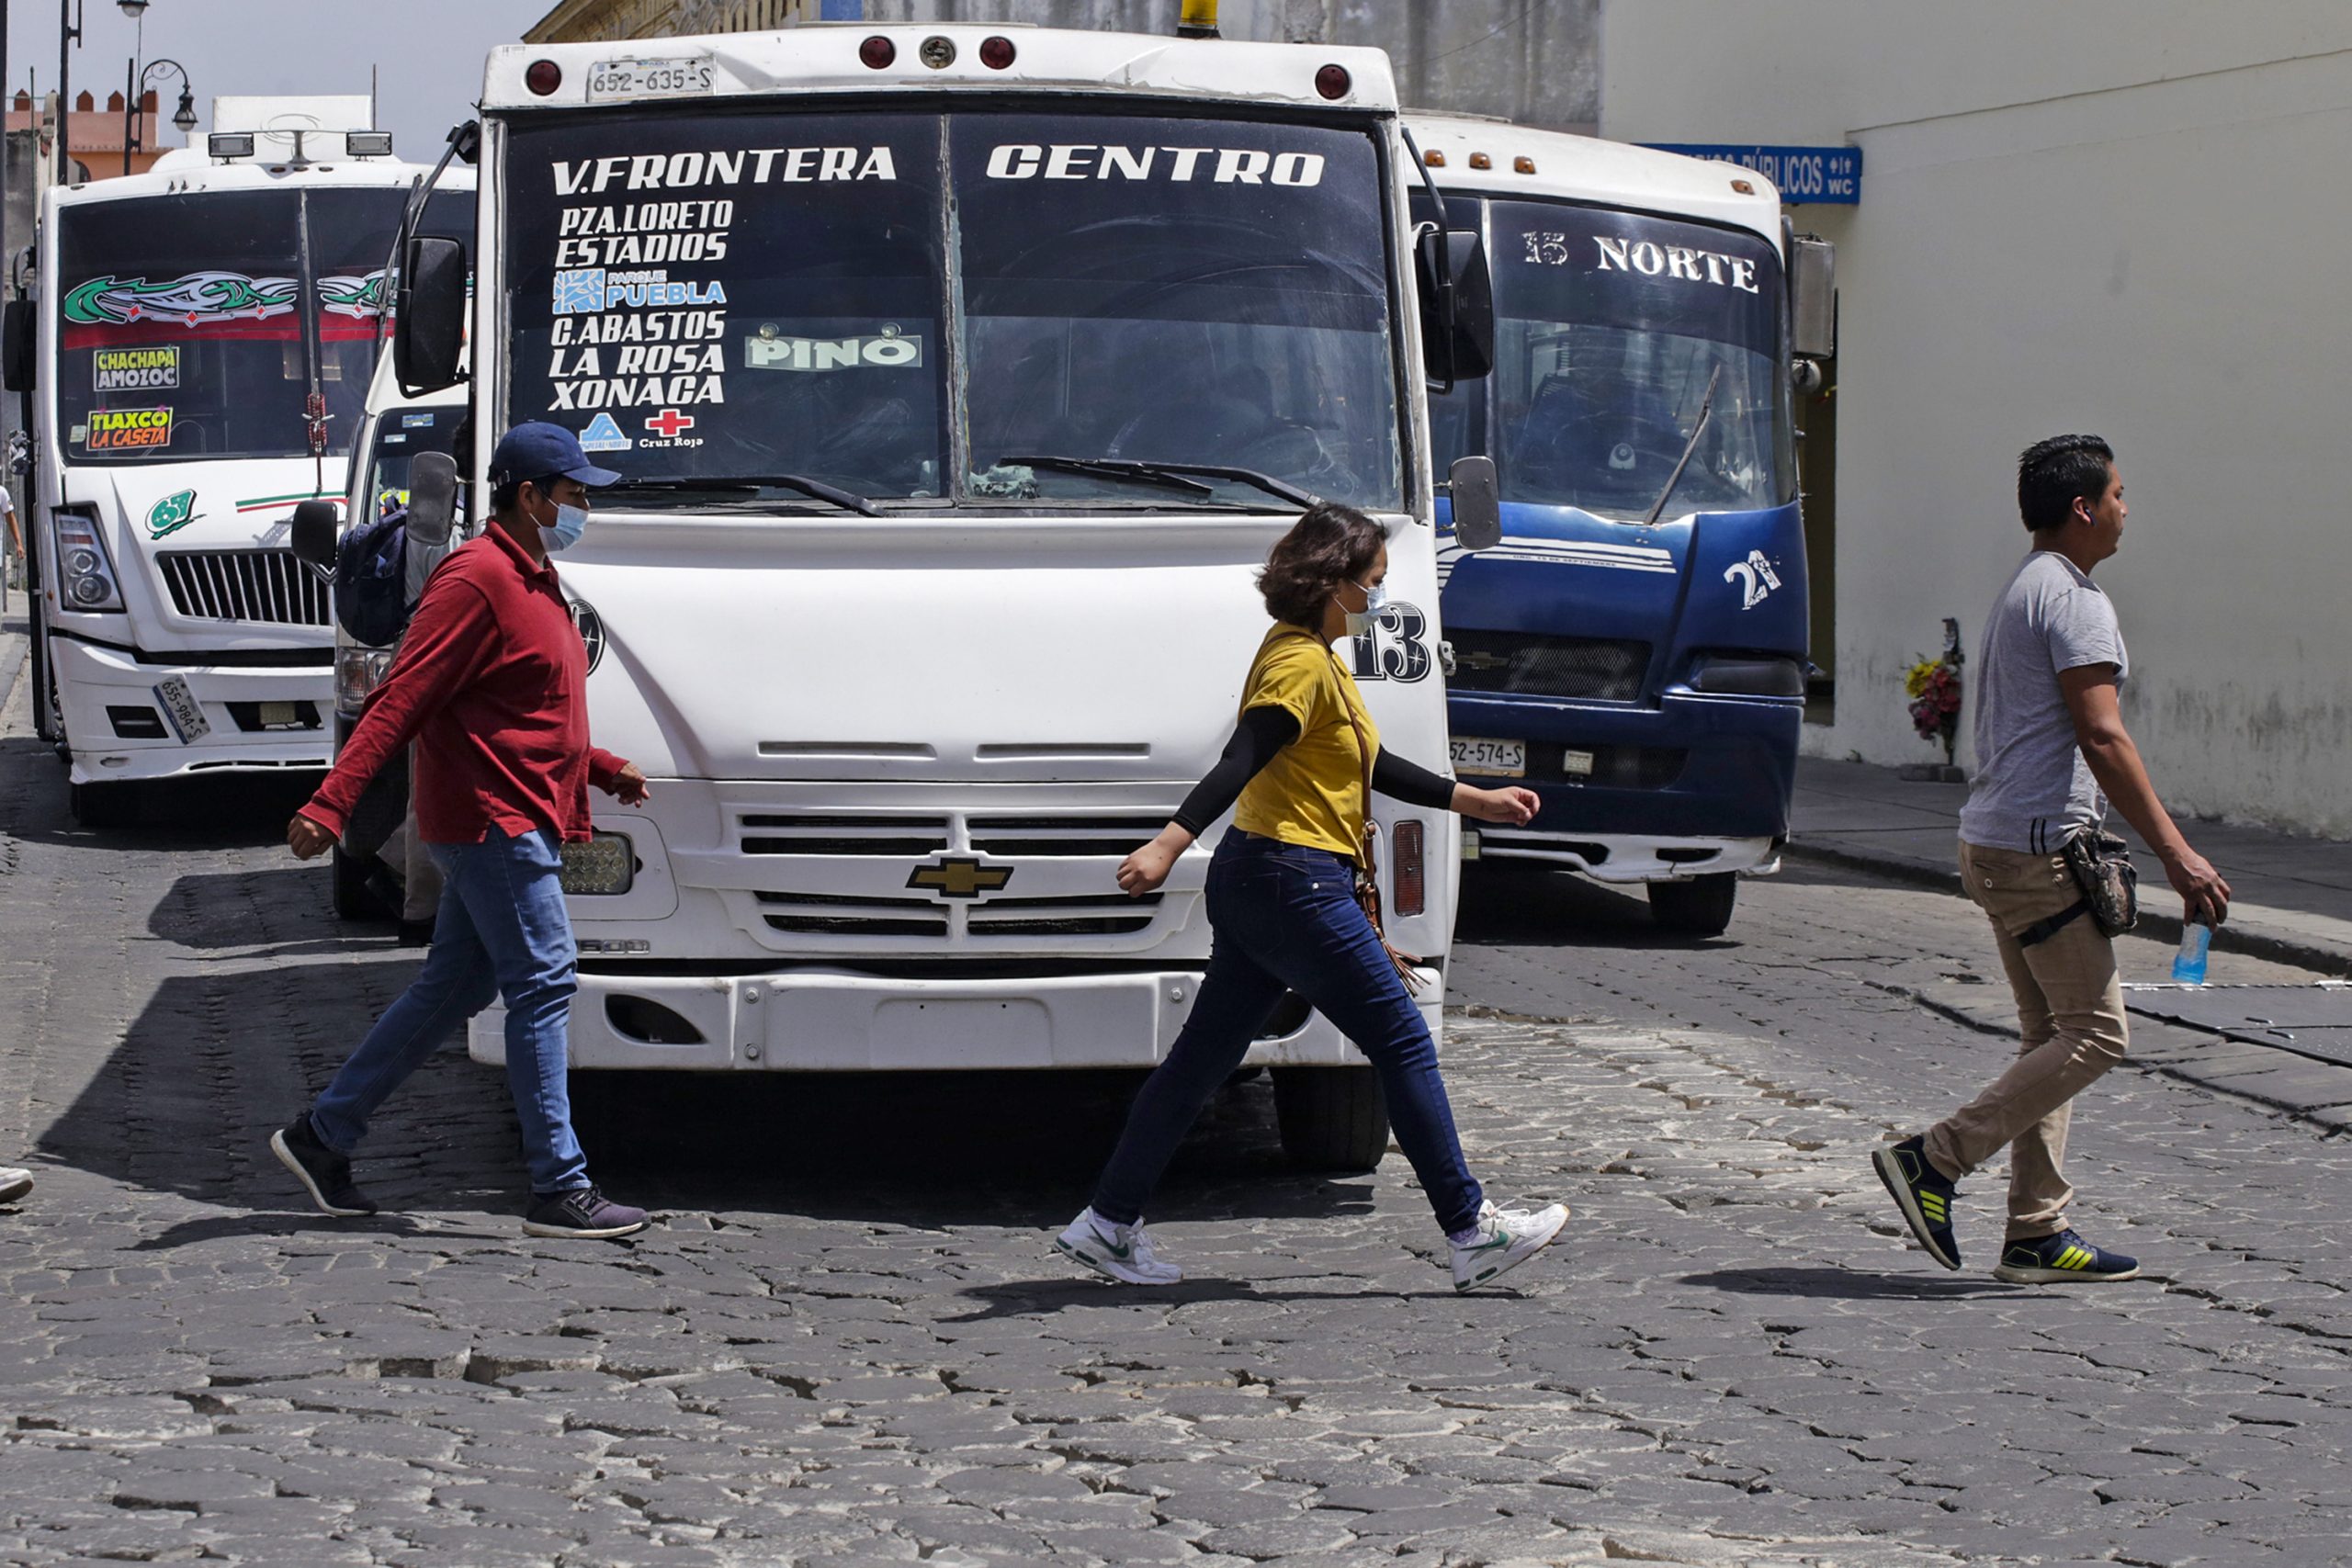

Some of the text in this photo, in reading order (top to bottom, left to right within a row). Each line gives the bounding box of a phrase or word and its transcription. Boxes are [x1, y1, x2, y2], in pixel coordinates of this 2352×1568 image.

[594, 67, 711, 92] 652-635-S
[552, 146, 897, 196] V.FRONTERA
[986, 144, 1325, 187] CENTRO
[1827, 178, 1853, 195] WC
[559, 199, 733, 236] PZA.LORETO
[555, 231, 729, 267] ESTADIOS
[607, 270, 667, 285] PARQUE
[1592, 235, 1758, 295] NORTE
[606, 280, 728, 309] PUEBLA
[551, 310, 728, 346] C.ABASTOS
[97, 351, 175, 370] CHACHAPA
[548, 344, 725, 378] LA ROSA
[750, 338, 917, 369] PINO
[97, 367, 175, 388] AMOZOC
[548, 375, 725, 411] XONACA
[92, 412, 168, 431] TLAXCO
[91, 427, 165, 448] LA CASETA
[639, 436, 704, 448] Cruz Roja
[1349, 600, 1431, 683] 13
[1449, 741, 1522, 765] 52-574-S
[575, 939, 650, 955] 500
